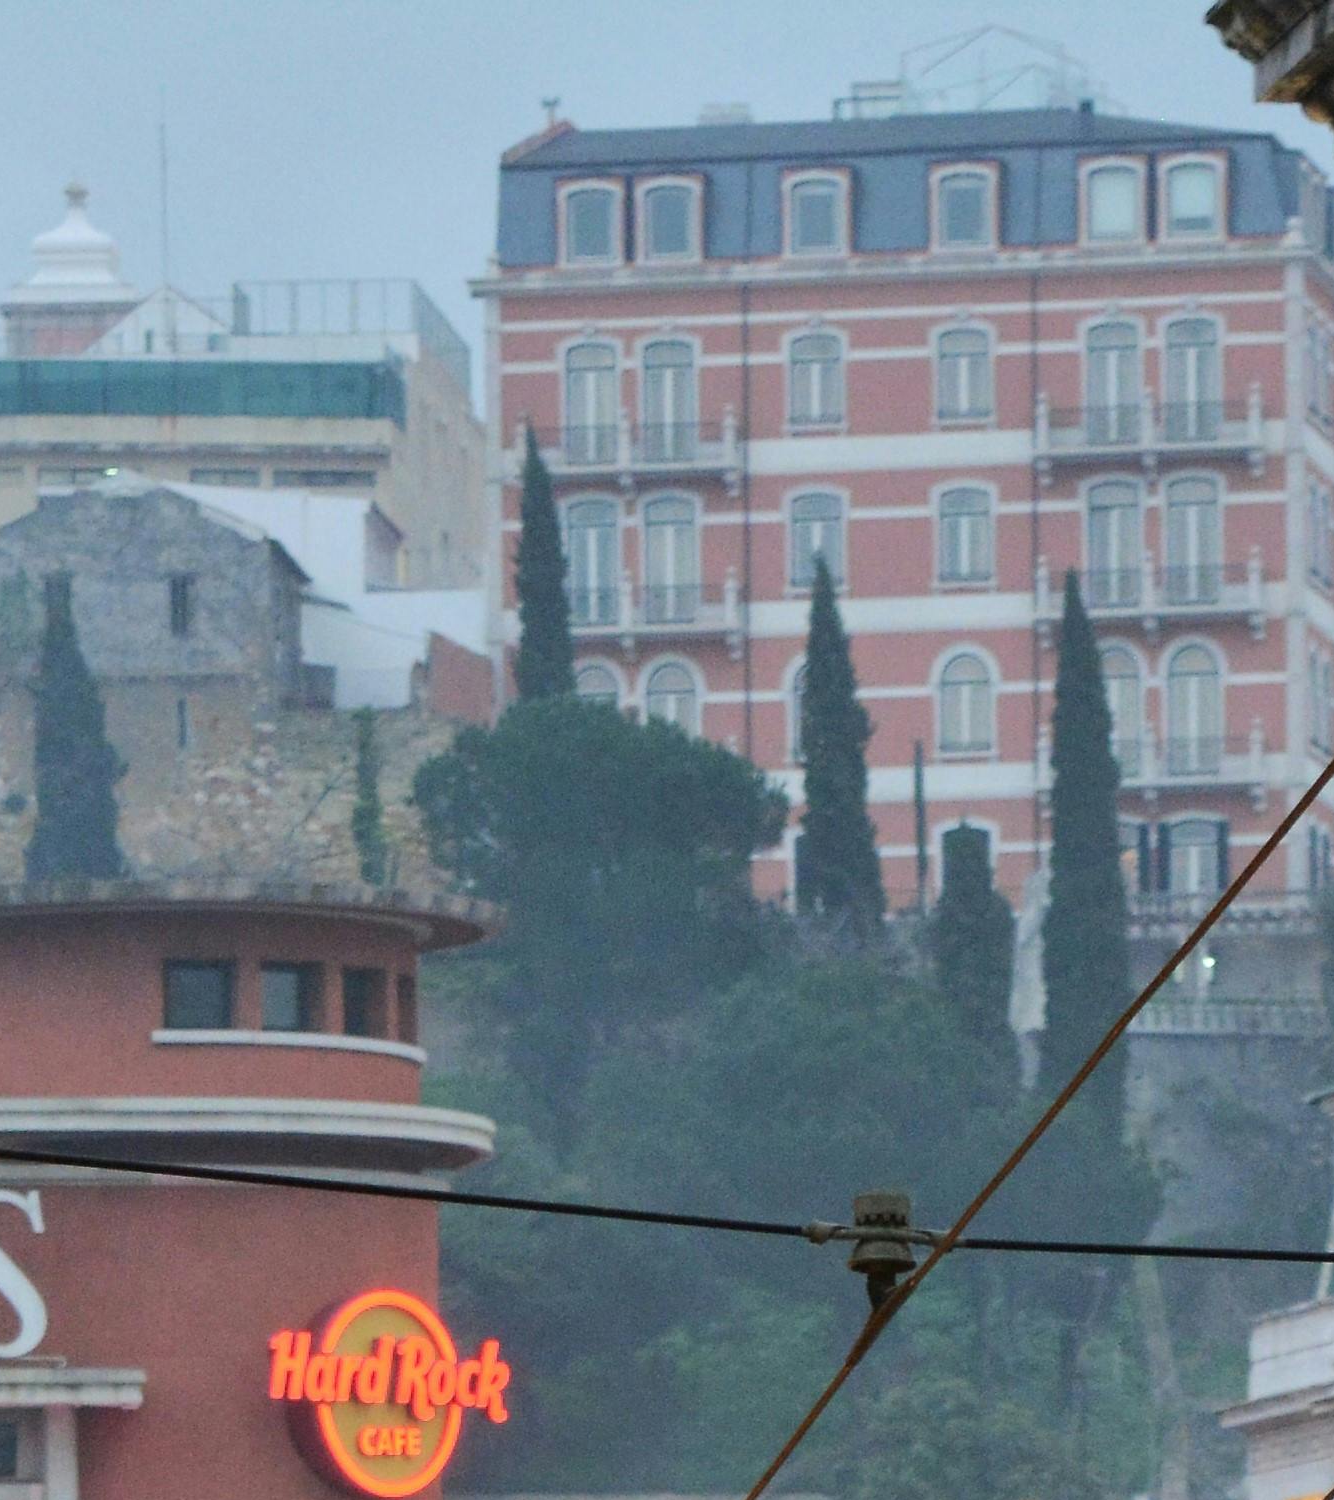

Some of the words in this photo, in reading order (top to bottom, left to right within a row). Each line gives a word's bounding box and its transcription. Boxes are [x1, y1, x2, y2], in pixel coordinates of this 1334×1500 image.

[269, 1330, 395, 1404] Hard
[395, 1333, 510, 1424] Rock
[359, 1427, 422, 1456] CAFE
